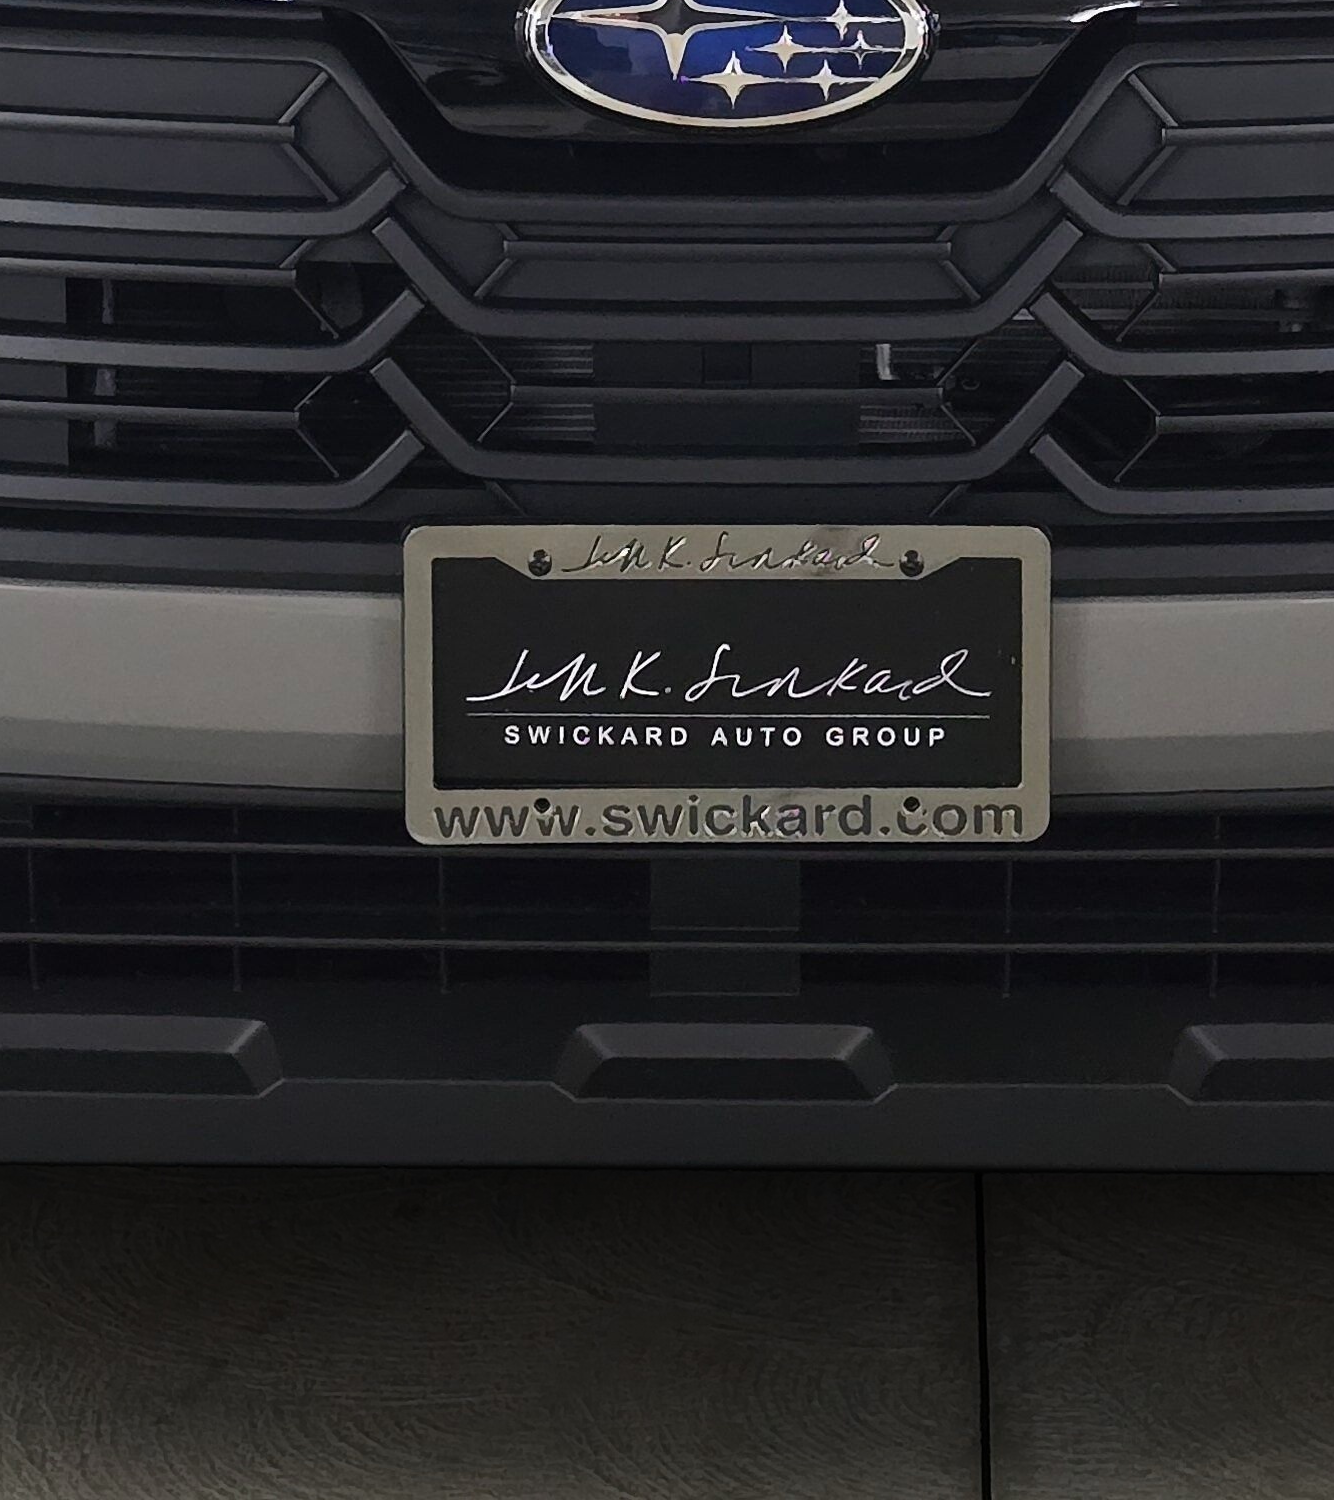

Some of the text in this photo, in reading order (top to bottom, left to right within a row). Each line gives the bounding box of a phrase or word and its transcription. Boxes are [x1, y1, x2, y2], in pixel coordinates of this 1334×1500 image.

[504, 725, 946, 747] SWICKARD AUTO GROUP
[433, 795, 1024, 838] www.swickard.com
